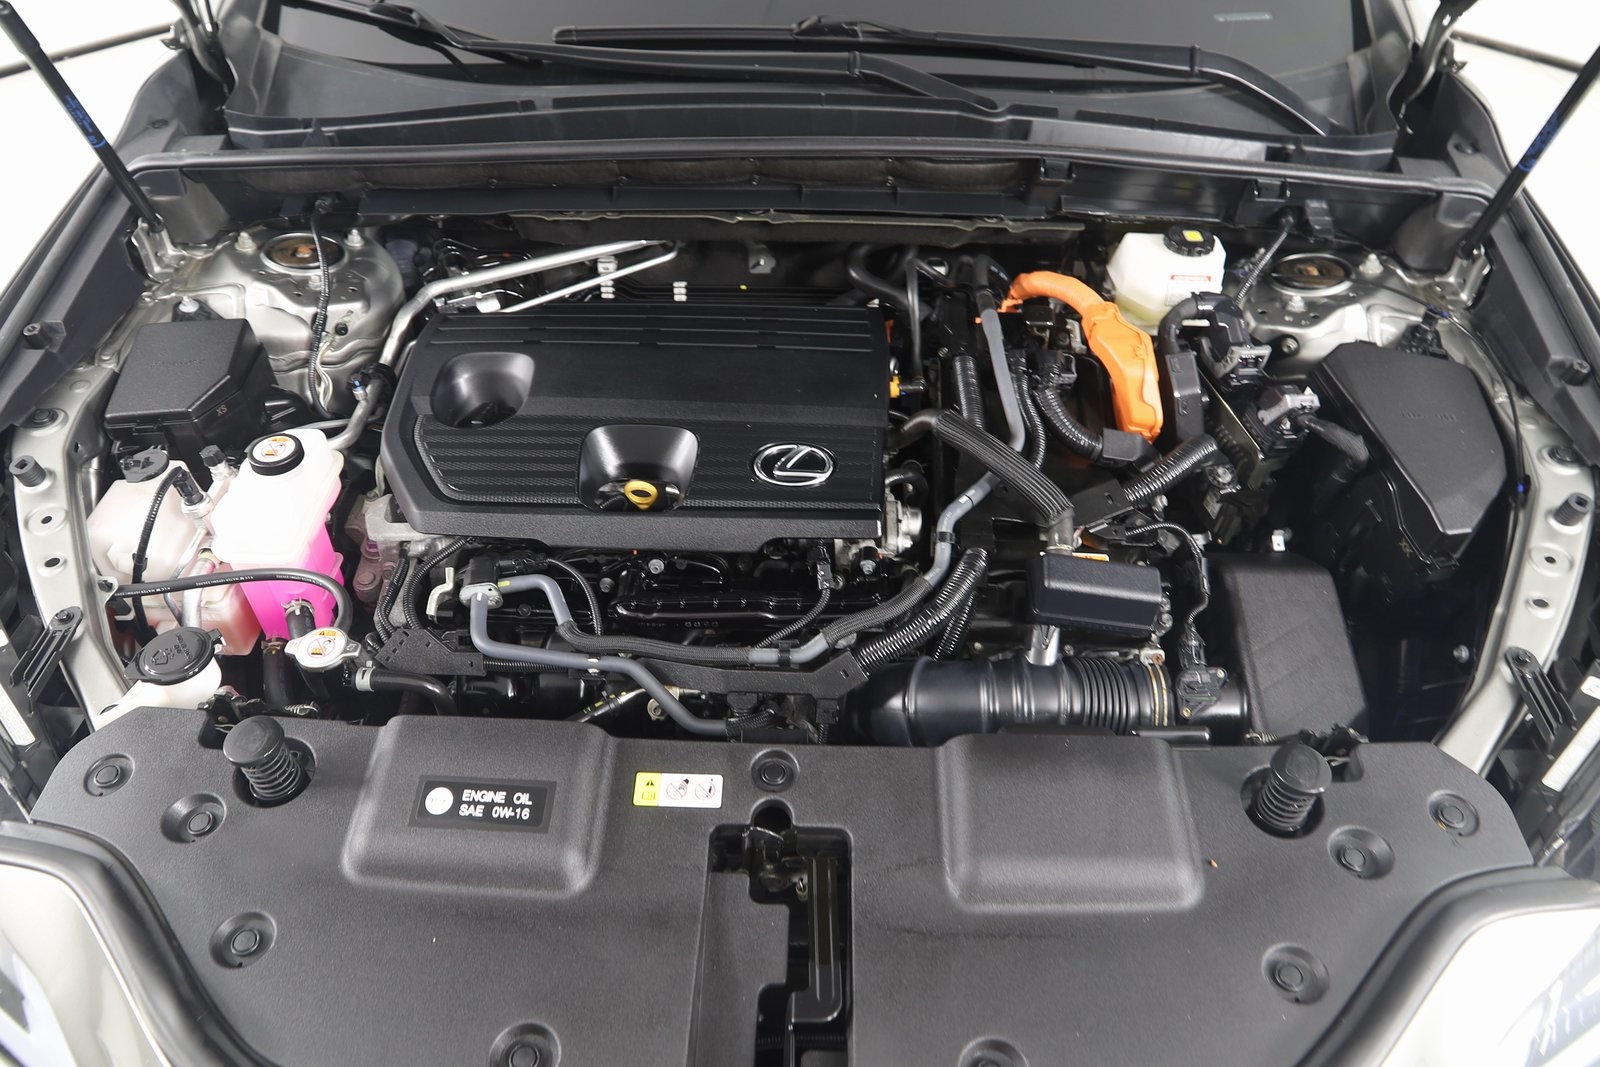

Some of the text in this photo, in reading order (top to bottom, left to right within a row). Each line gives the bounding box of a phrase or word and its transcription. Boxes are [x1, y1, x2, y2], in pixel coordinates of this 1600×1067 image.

[461, 789, 533, 806] ENGINE OIL
[459, 804, 531, 820] SAE 0W-16
